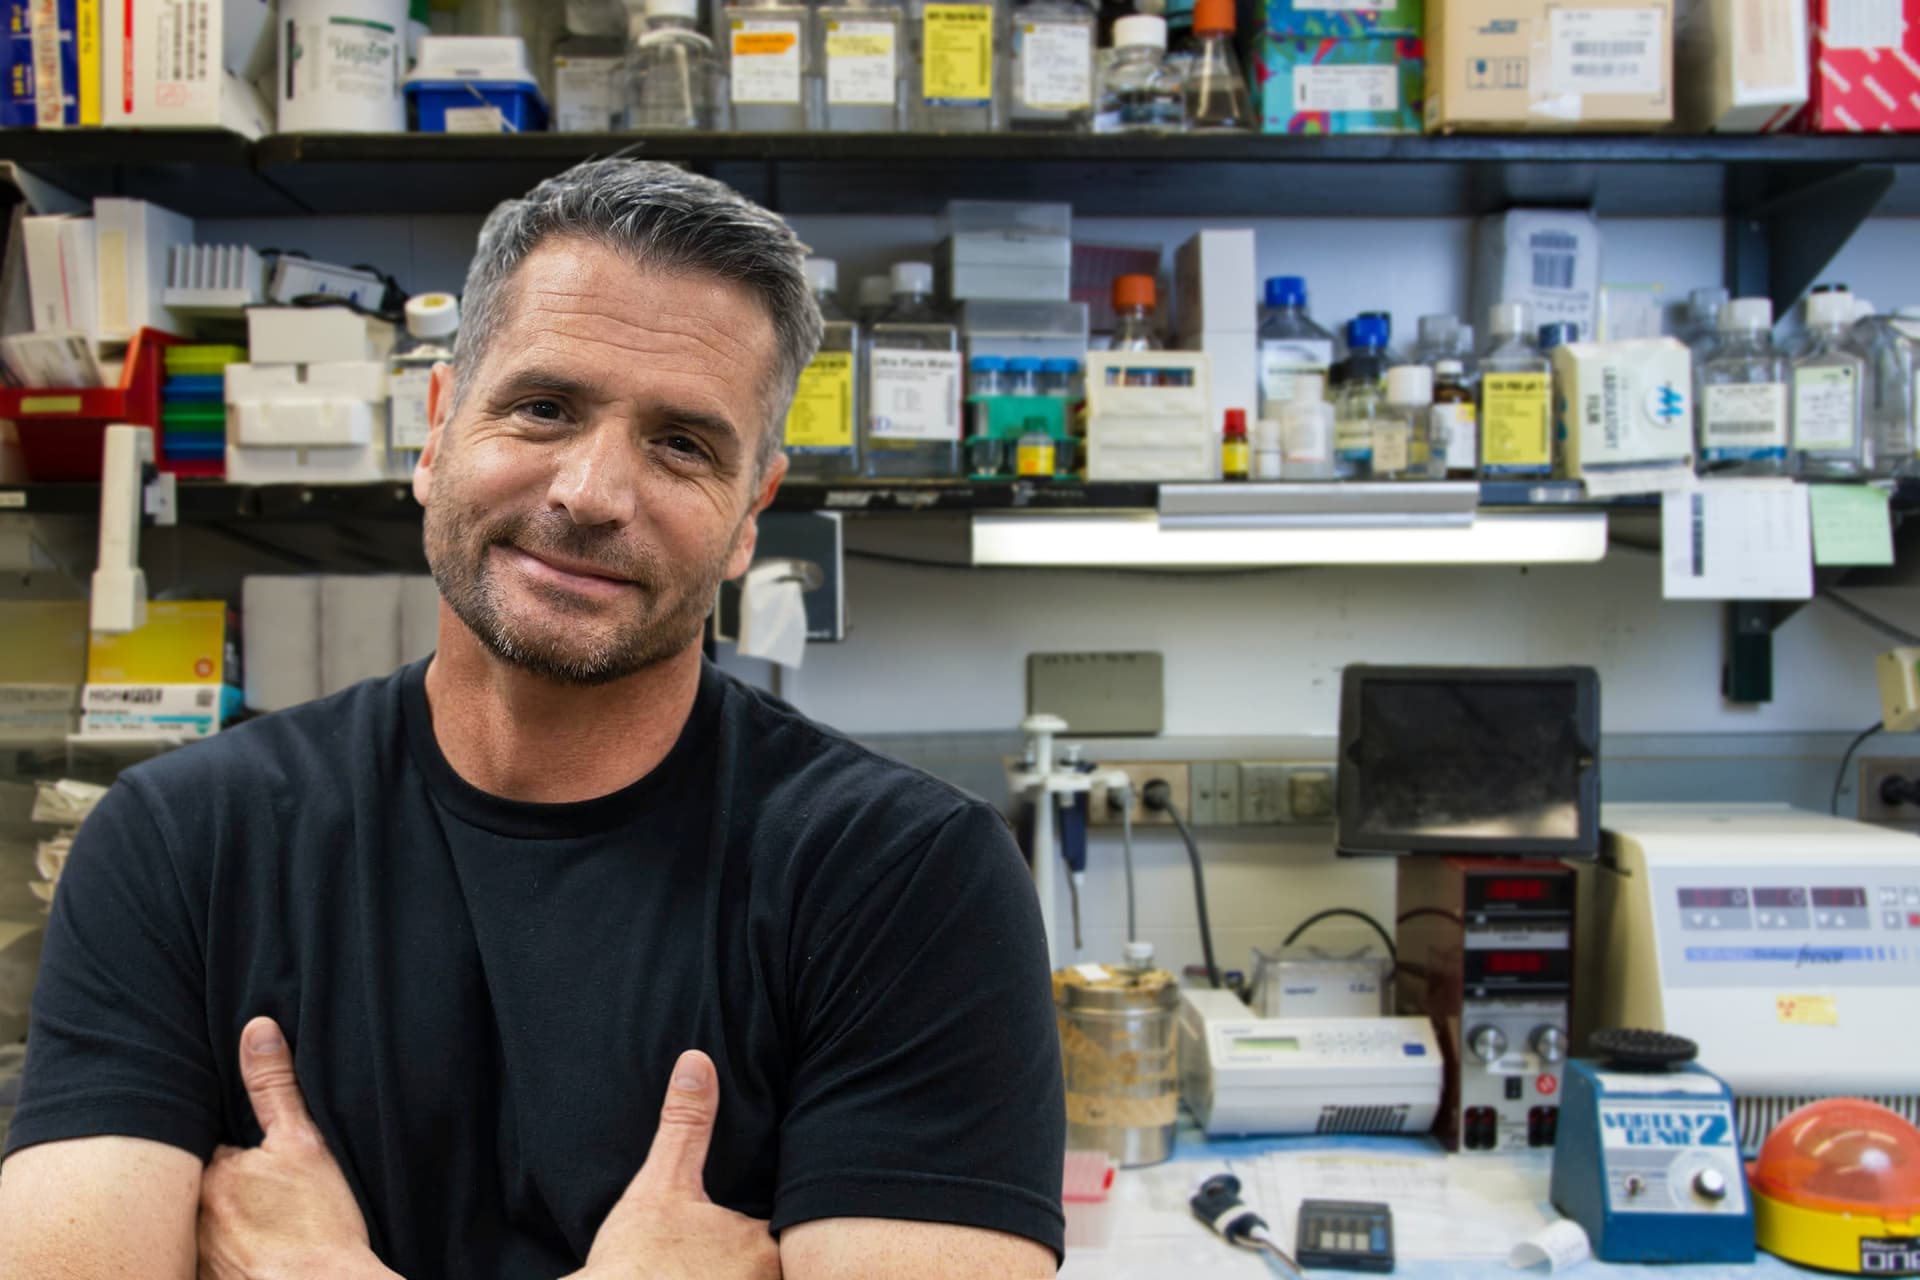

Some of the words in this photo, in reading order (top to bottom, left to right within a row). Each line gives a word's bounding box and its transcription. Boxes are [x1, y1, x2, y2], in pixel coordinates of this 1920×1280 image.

[1586, 394, 1600, 424] FILM
[1603, 1112, 1692, 1129] VORTEX
[1626, 1129, 1692, 1145] GENIE
[1695, 1113, 1733, 1147] 2
